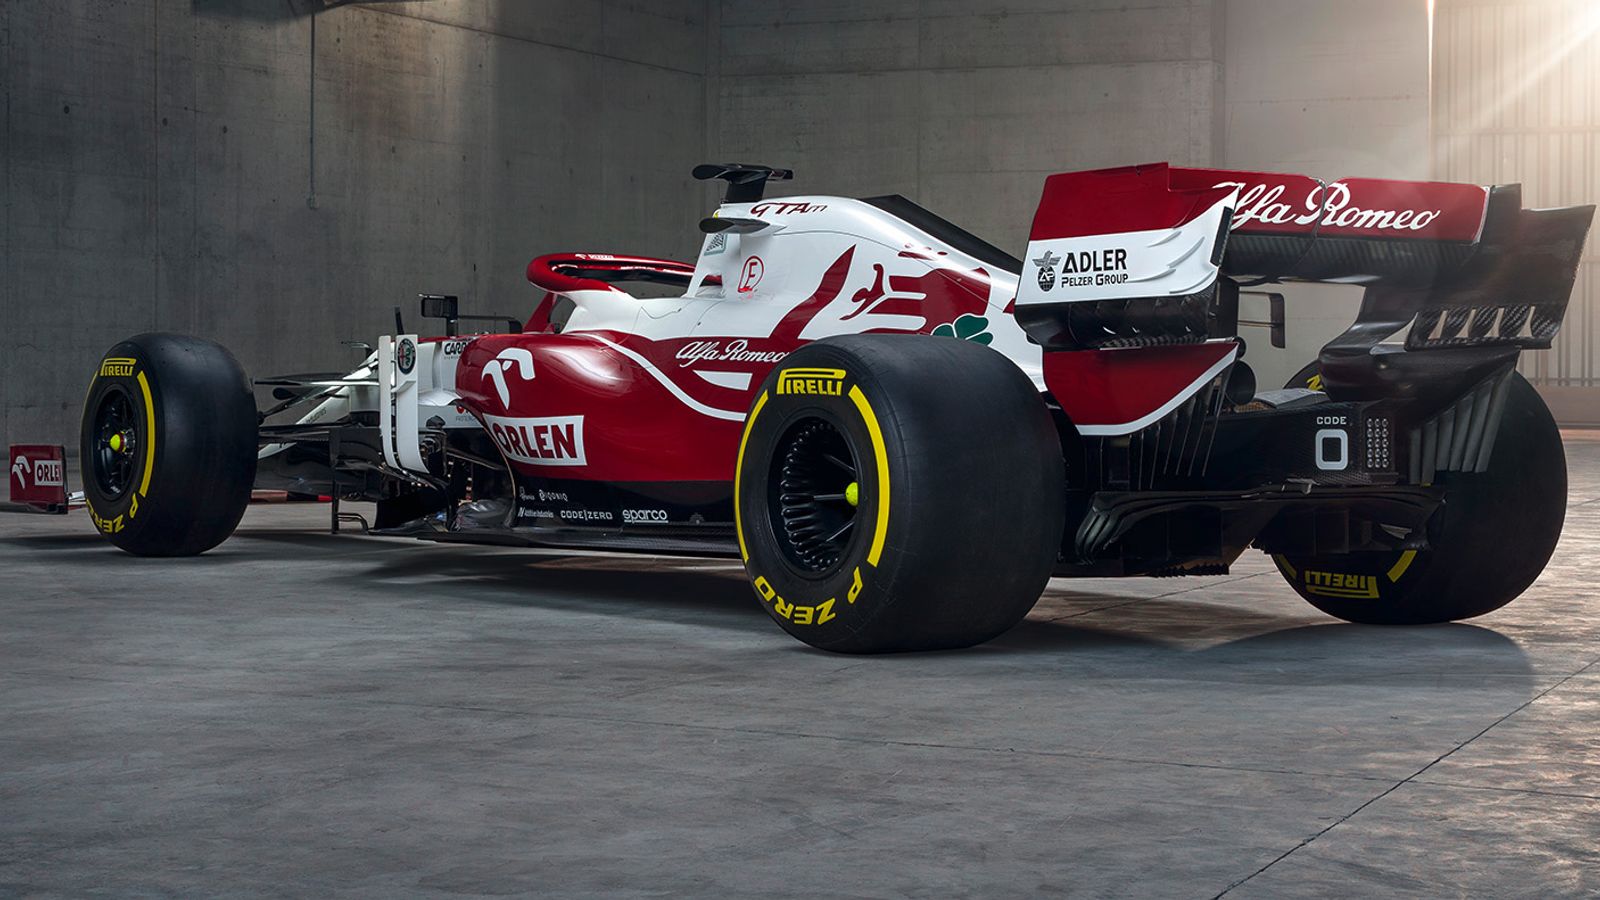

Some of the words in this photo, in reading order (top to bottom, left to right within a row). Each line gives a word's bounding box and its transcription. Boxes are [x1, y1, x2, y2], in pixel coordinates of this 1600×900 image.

[1295, 182, 1440, 230] Romeo
[1062, 248, 1127, 274] ADLER
[100, 357, 137, 377] PIRELLI
[675, 341, 720, 368] Alfa
[719, 339, 790, 363] Romeo
[776, 367, 846, 396] PIRELLI
[1316, 416, 1347, 425] CODE
[492, 422, 578, 459] ORLEN
[129, 492, 139, 519] P
[622, 509, 669, 523] sparco
[847, 566, 864, 604] P
[1304, 570, 1380, 599] PIRELLI
[754, 575, 837, 625] ZERO
